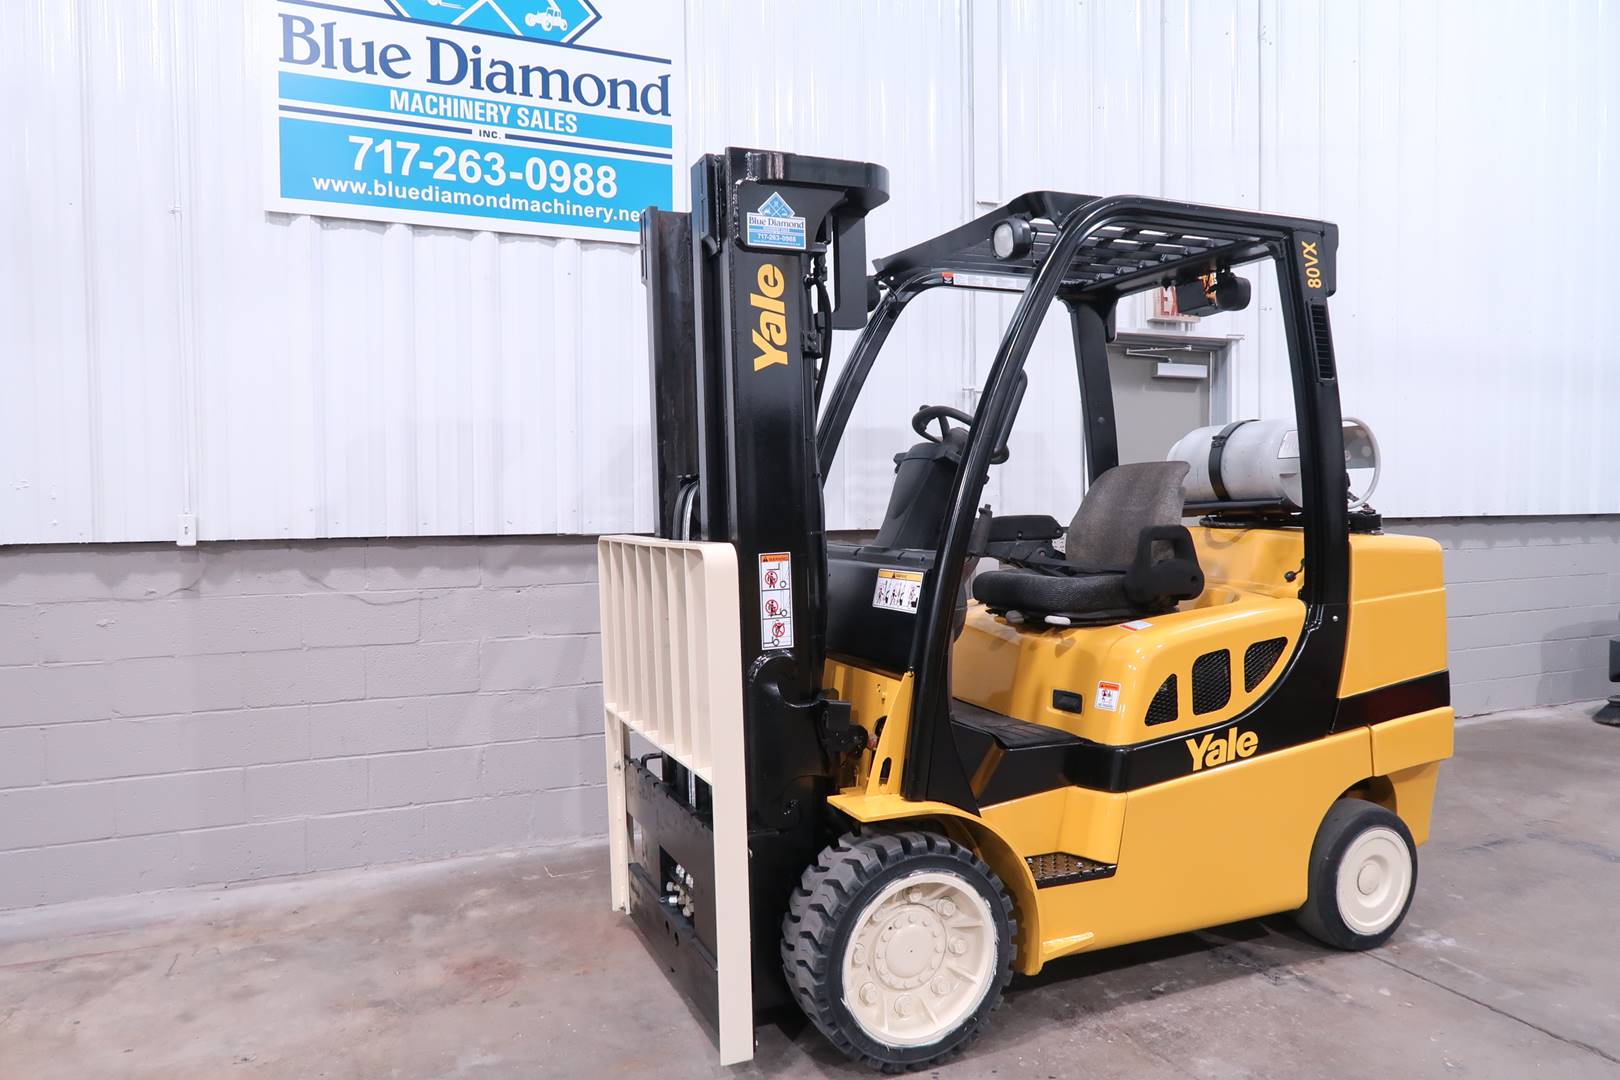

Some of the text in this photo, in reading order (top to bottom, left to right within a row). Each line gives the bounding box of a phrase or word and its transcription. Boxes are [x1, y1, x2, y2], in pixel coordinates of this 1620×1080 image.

[279, 13, 671, 116] Blue Diamond
[390, 90, 578, 133] MACHINERY SALES
[479, 130, 502, 140] INC.
[348, 136, 617, 199] 717-263-0988
[312, 176, 643, 223] www.bluediamondmachinery.ne
[749, 217, 767, 226] Blue
[768, 218, 804, 229] Diamond
[1301, 240, 1321, 288] 80VX
[751, 264, 788, 371] Yale
[1186, 727, 1259, 771] Yale
